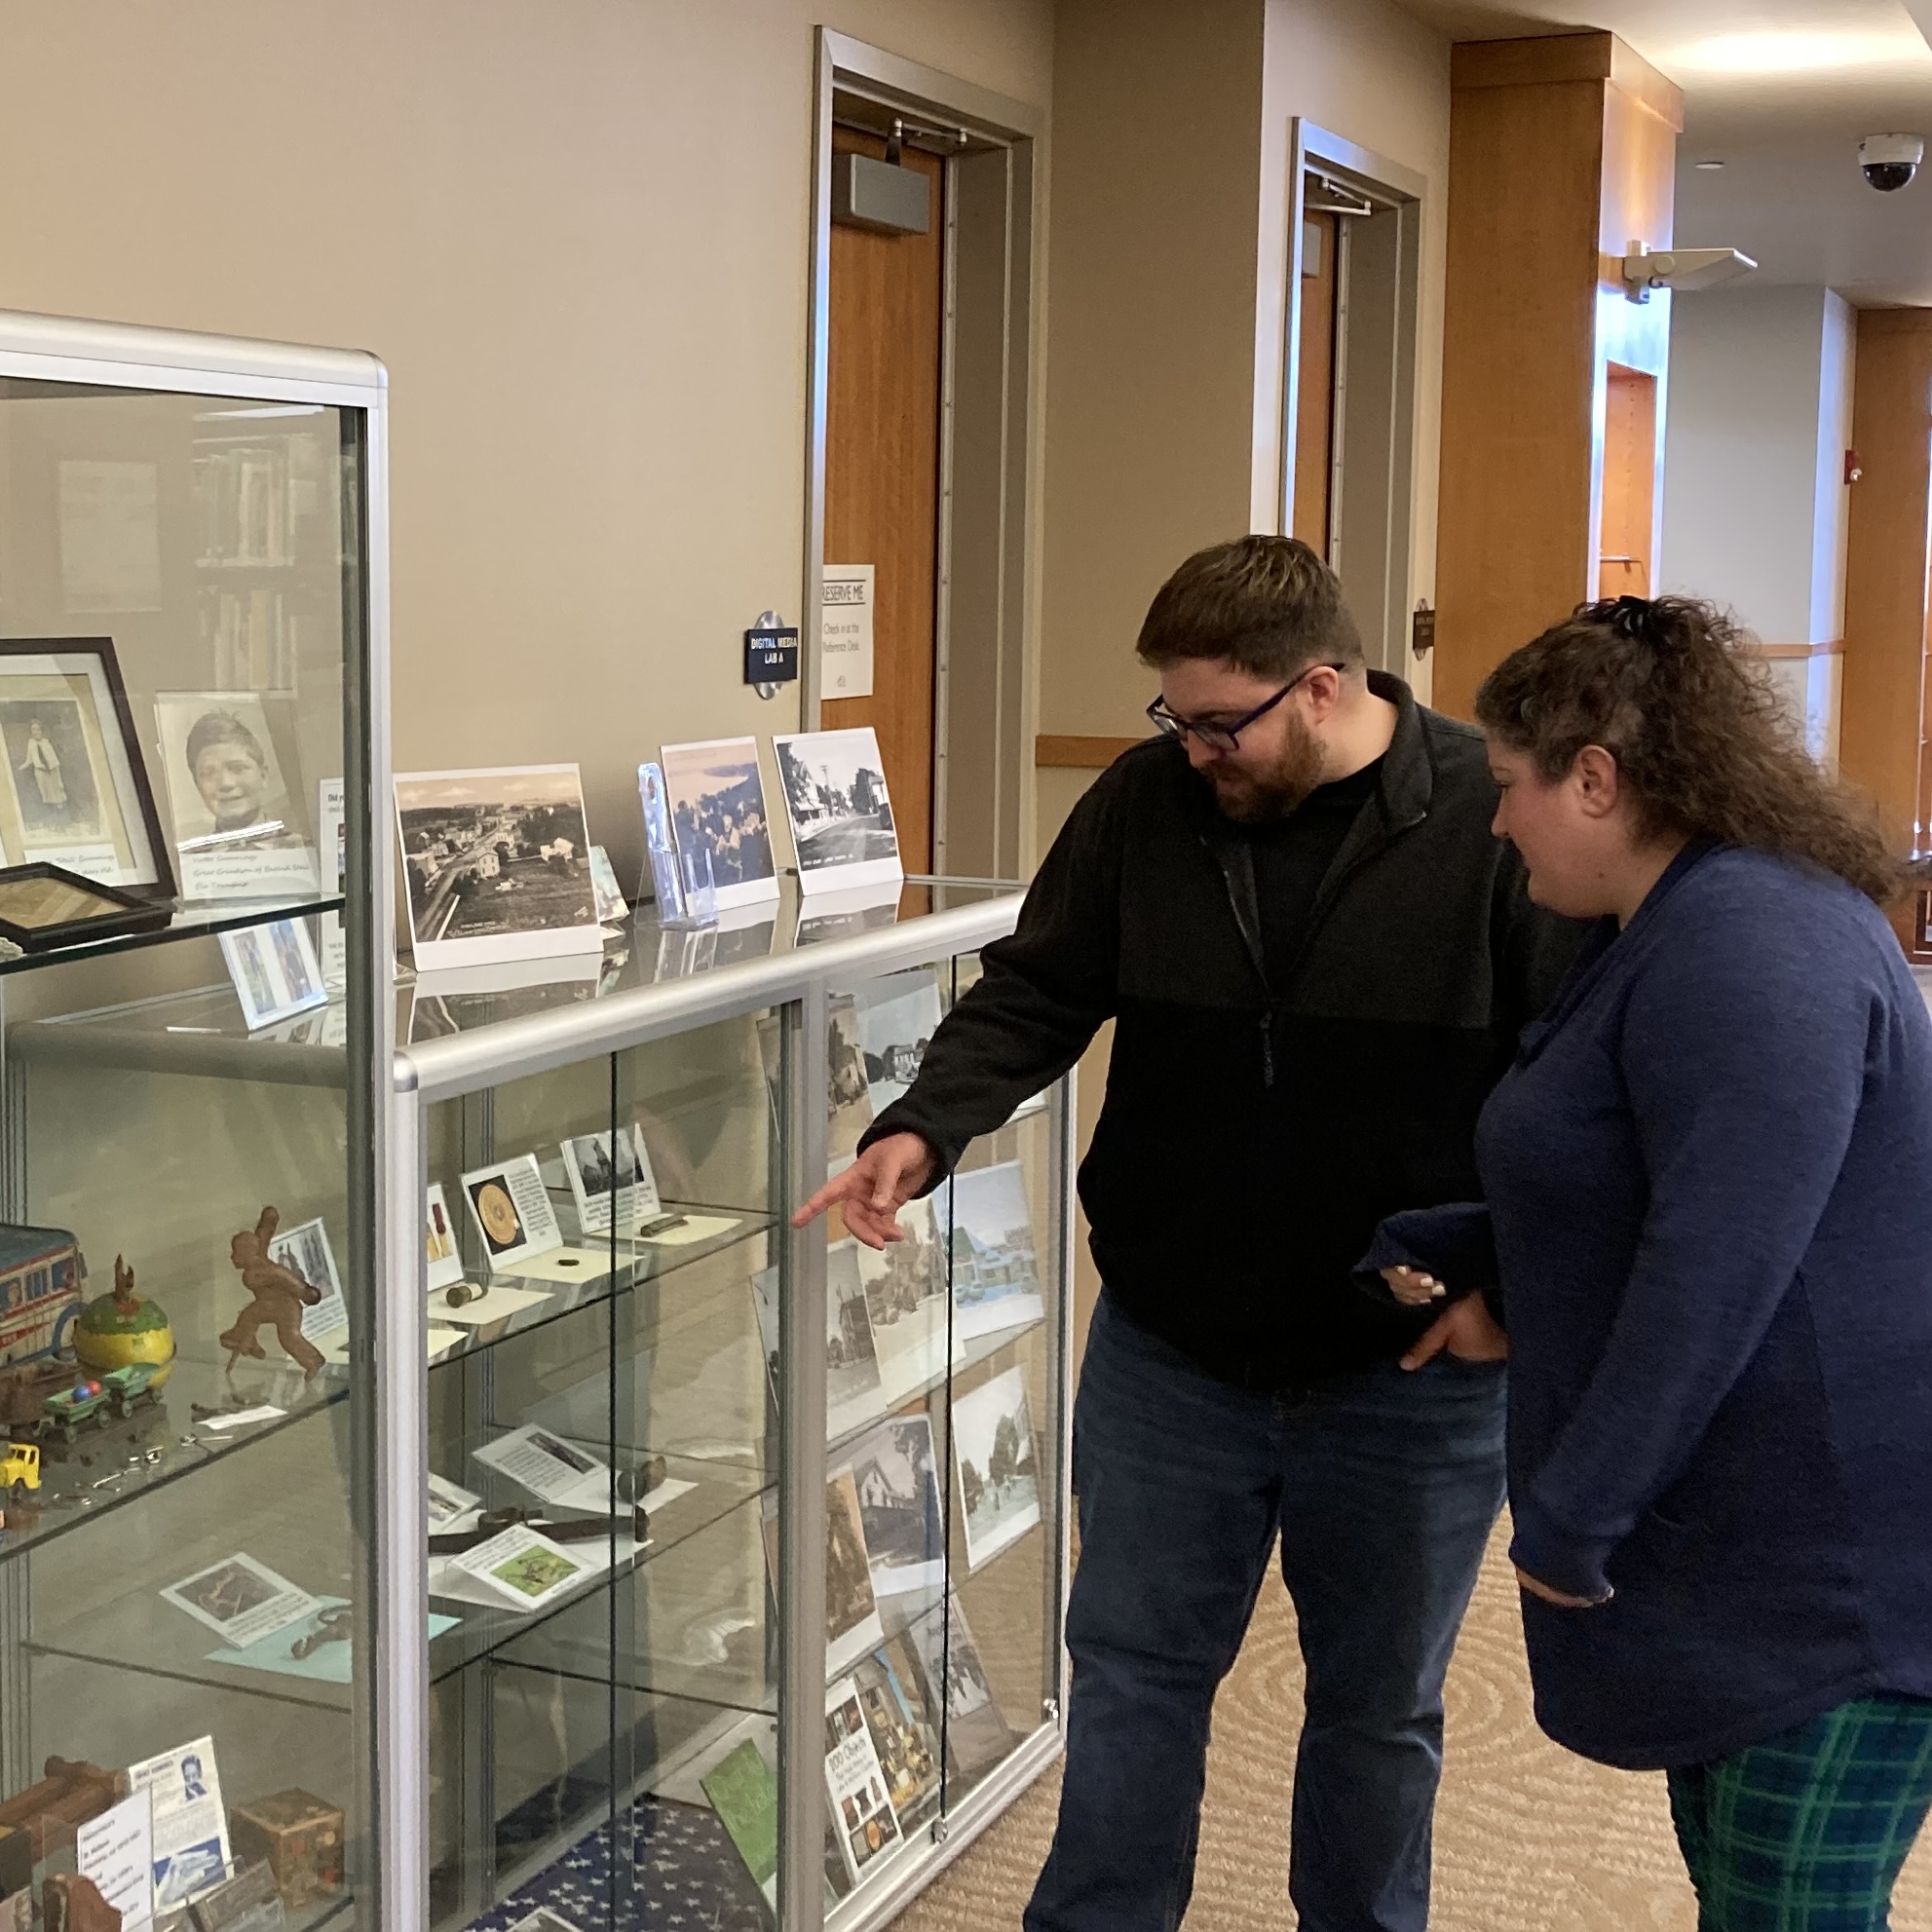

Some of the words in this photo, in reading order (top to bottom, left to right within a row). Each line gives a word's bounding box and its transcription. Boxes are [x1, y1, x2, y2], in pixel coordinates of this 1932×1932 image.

[852, 585, 864, 600] ME
[823, 623, 839, 635] Check
[751, 637, 777, 650] DIGITAL
[777, 636, 798, 649] MEDIA
[765, 652, 777, 664] LAB
[778, 652, 784, 664] A
